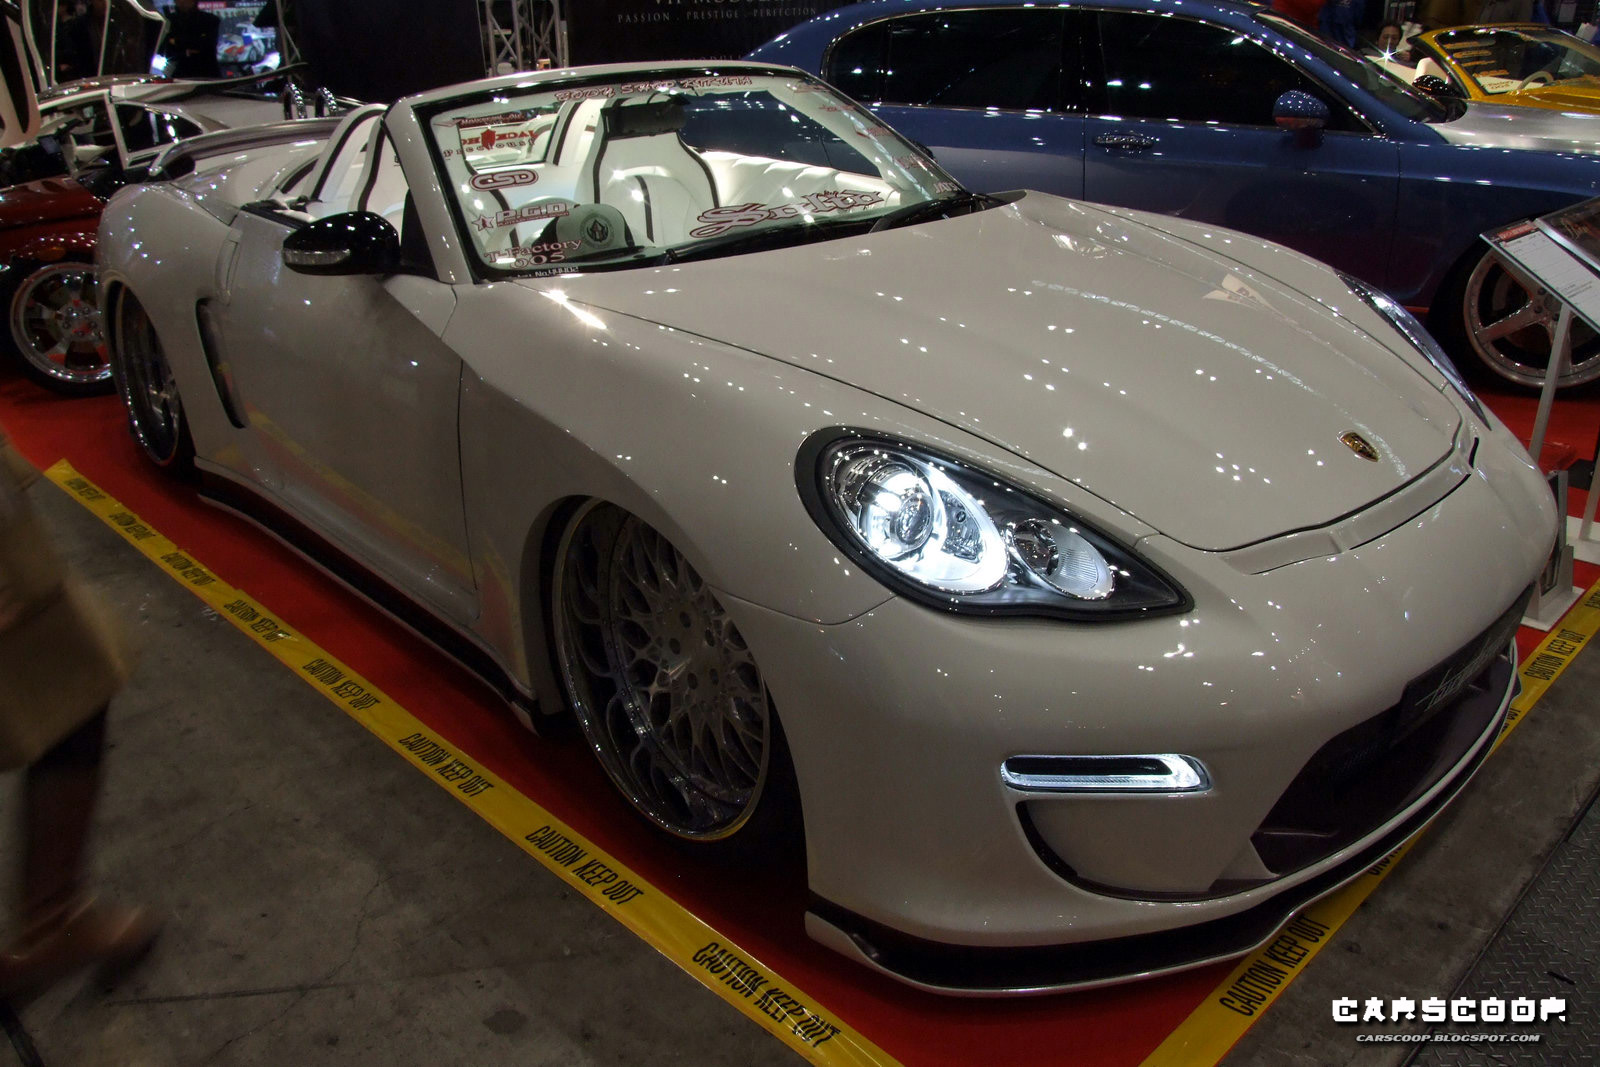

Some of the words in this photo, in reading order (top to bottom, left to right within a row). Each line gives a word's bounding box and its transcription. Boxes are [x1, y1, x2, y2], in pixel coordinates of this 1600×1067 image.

[470, 169, 539, 191] CSD
[302, 658, 346, 686] CAUTION
[331, 680, 365, 700] KEEP
[348, 692, 381, 711] OUT
[398, 733, 453, 767] CAUTION
[435, 757, 474, 782] KEEP
[458, 775, 495, 798] OUT
[525, 825, 588, 867] CAUTION
[572, 859, 619, 886] KEEP
[602, 880, 645, 905] OUT
[692, 942, 769, 998] CAUTION
[754, 988, 805, 1023] KEEP
[792, 1014, 842, 1048] OUT
[1218, 958, 1289, 1017] CAUTION
[1263, 934, 1311, 969] KEEP
[1291, 915, 1331, 944] OUT
